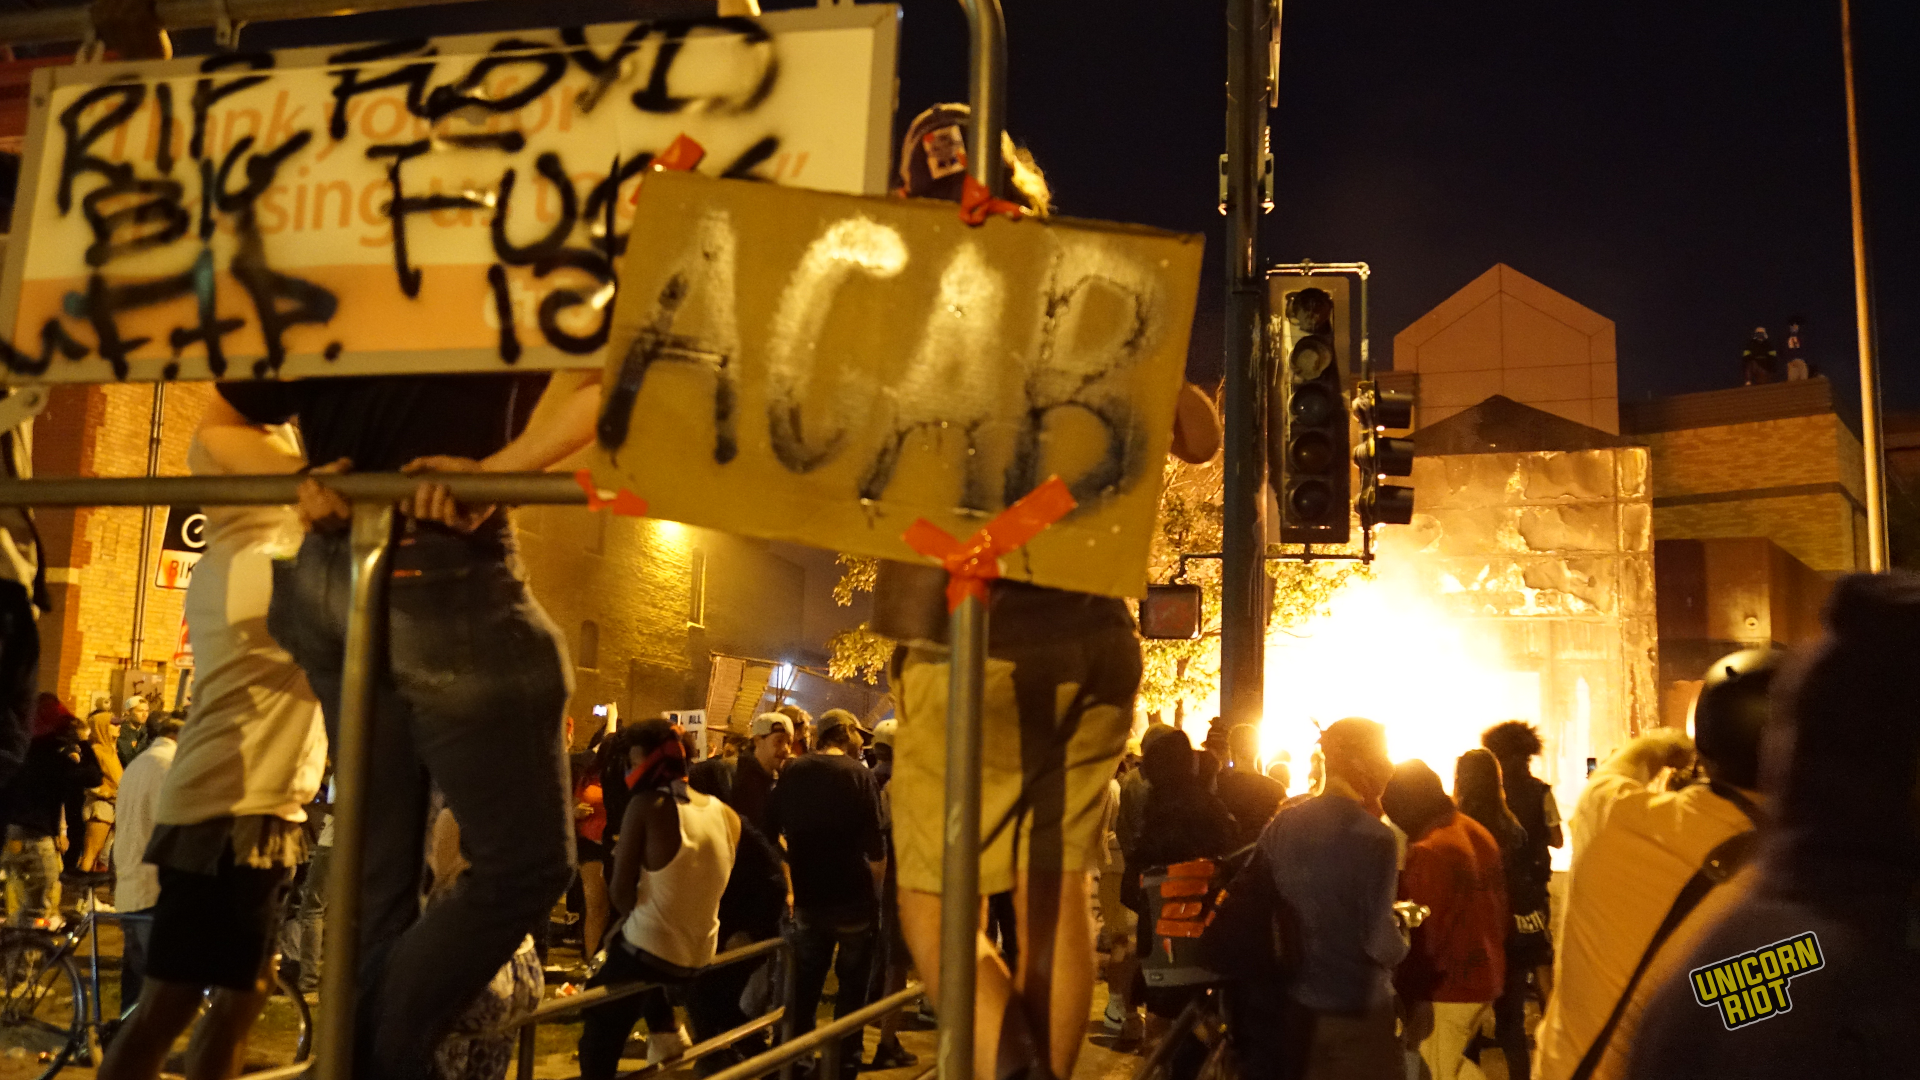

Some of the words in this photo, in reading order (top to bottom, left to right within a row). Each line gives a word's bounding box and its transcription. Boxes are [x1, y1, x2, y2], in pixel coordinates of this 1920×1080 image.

[364, 128, 780, 300] FUC
[596, 208, 1160, 518] ACAB
[169, 559, 197, 580] BIK
